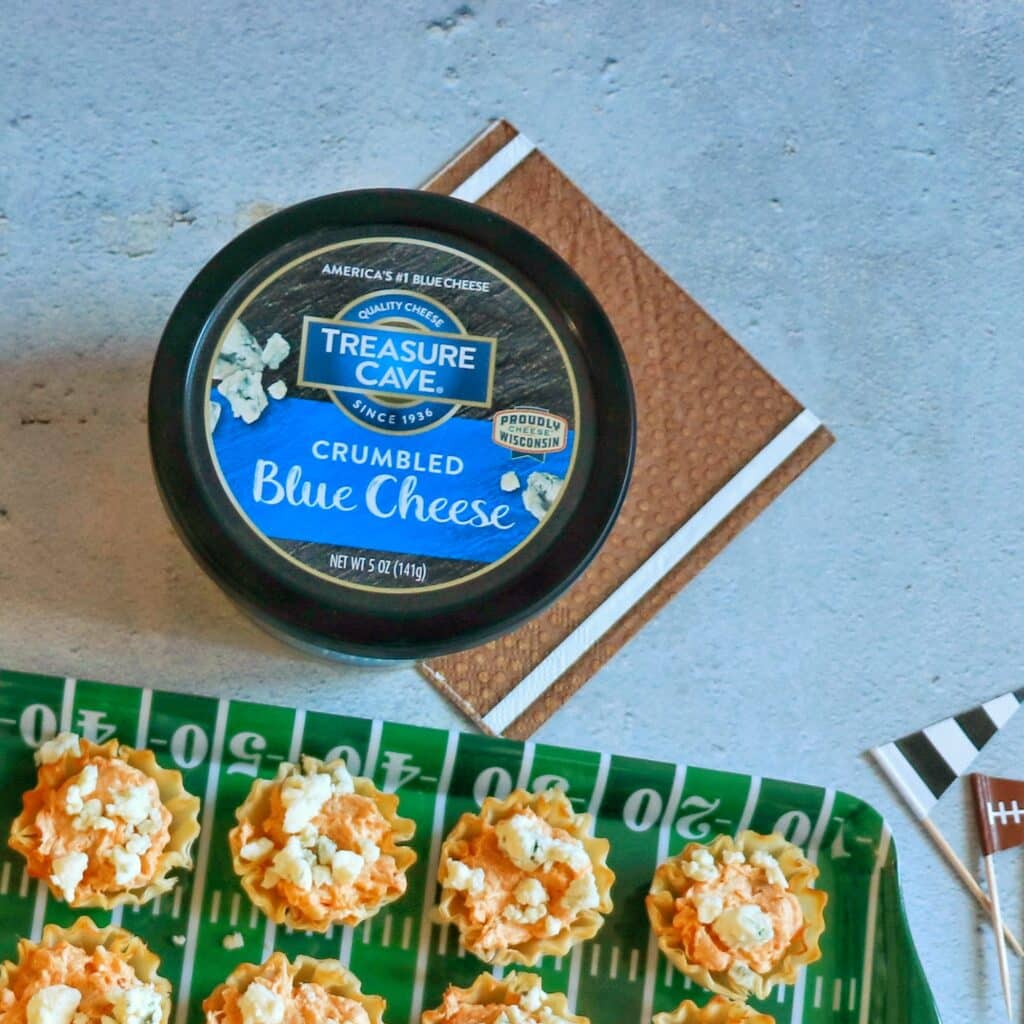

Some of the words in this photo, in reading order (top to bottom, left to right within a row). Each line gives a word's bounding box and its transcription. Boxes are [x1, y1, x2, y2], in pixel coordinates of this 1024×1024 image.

[321, 264, 393, 283] AMERICA'S
[396, 271, 409, 284] #1
[358, 301, 403, 320] QUALITY
[405, 302, 445, 329] CHEESE
[321, 327, 477, 370] TREASURE
[352, 399, 397, 425] SINCE
[402, 407, 433, 425] 1936
[500, 414, 561, 431] PROUDLY
[499, 430, 560, 449] WISCONSIN
[311, 440, 465, 476] CRUMBLED
[252, 458, 358, 513] Blue
[365, 474, 515, 530] Cheese
[329, 553, 348, 569] NET
[350, 556, 367, 572] WT
[367, 559, 376, 573] 5
[378, 560, 392, 575] OZ
[394, 561, 427, 583] (141g)
